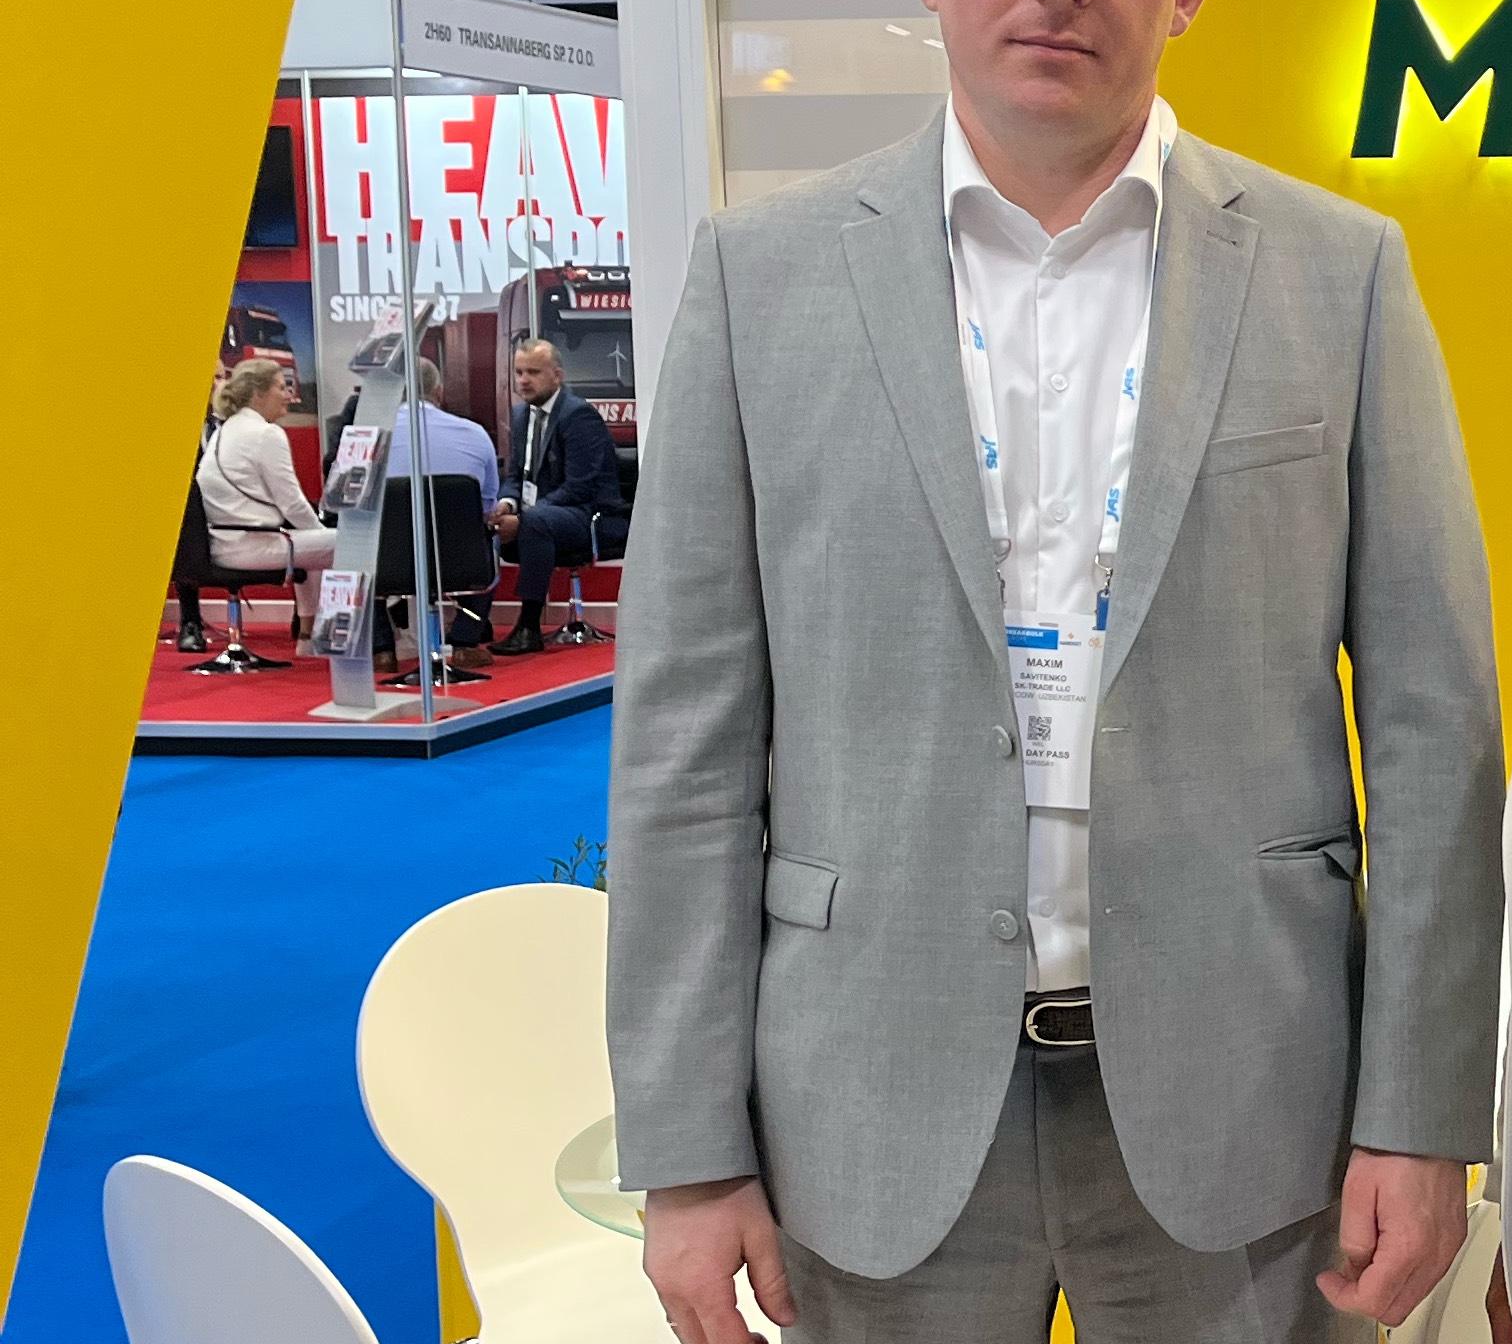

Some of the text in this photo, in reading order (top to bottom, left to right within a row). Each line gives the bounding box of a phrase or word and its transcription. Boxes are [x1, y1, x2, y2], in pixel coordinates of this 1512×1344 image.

[424, 22, 451, 42] 2H60
[457, 26, 551, 60] TRANSANNABERG
[1026, 657, 1063, 669] MAXIM
